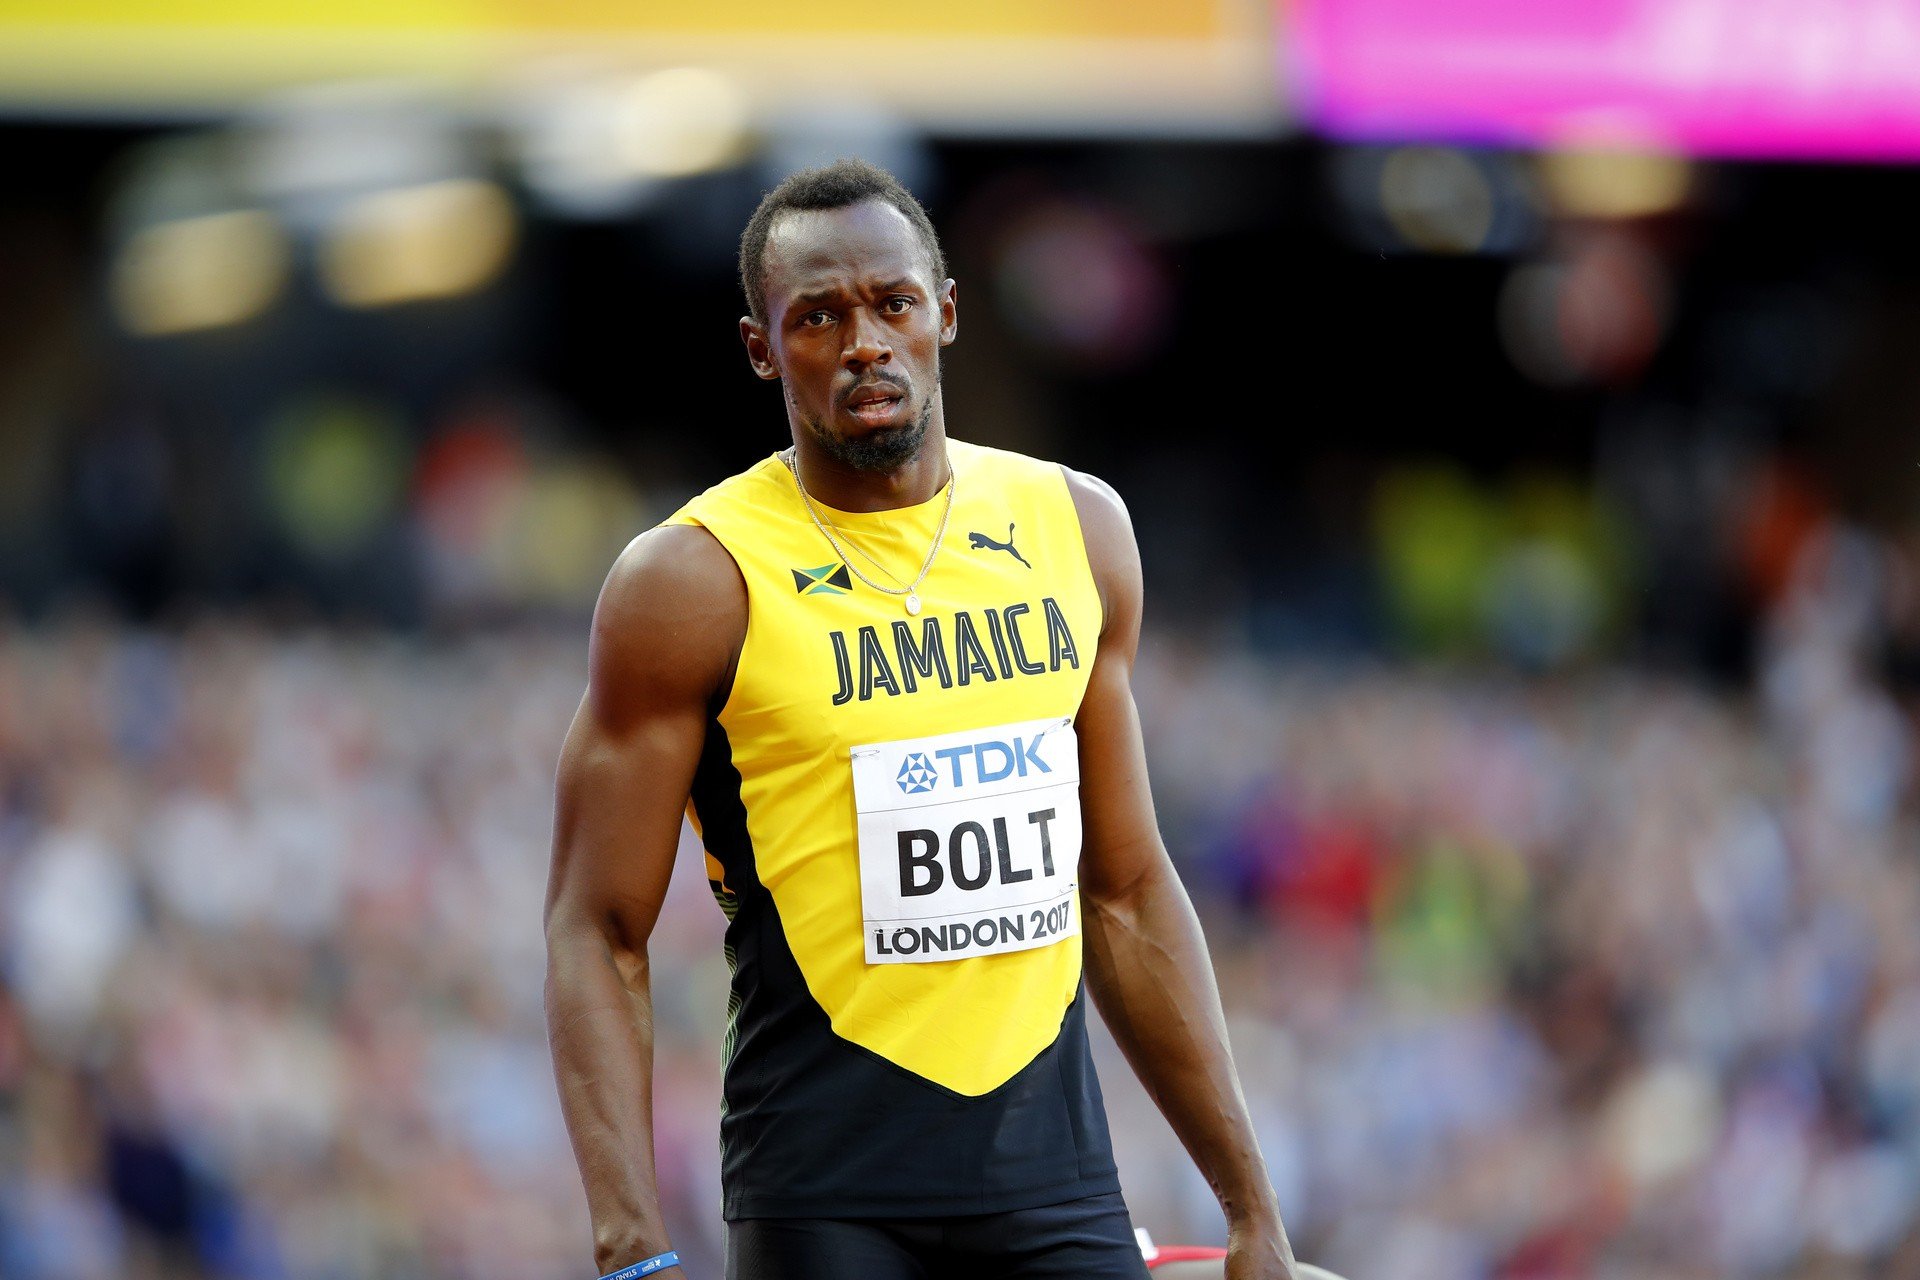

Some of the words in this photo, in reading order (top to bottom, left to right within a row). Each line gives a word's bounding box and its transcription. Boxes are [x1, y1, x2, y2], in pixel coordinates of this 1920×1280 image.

[829, 597, 1080, 705] JAMAICA
[935, 733, 1053, 787] TDK
[897, 807, 1056, 898] BOLT
[876, 914, 1025, 955] LONDON
[1030, 900, 1070, 939] 2017
